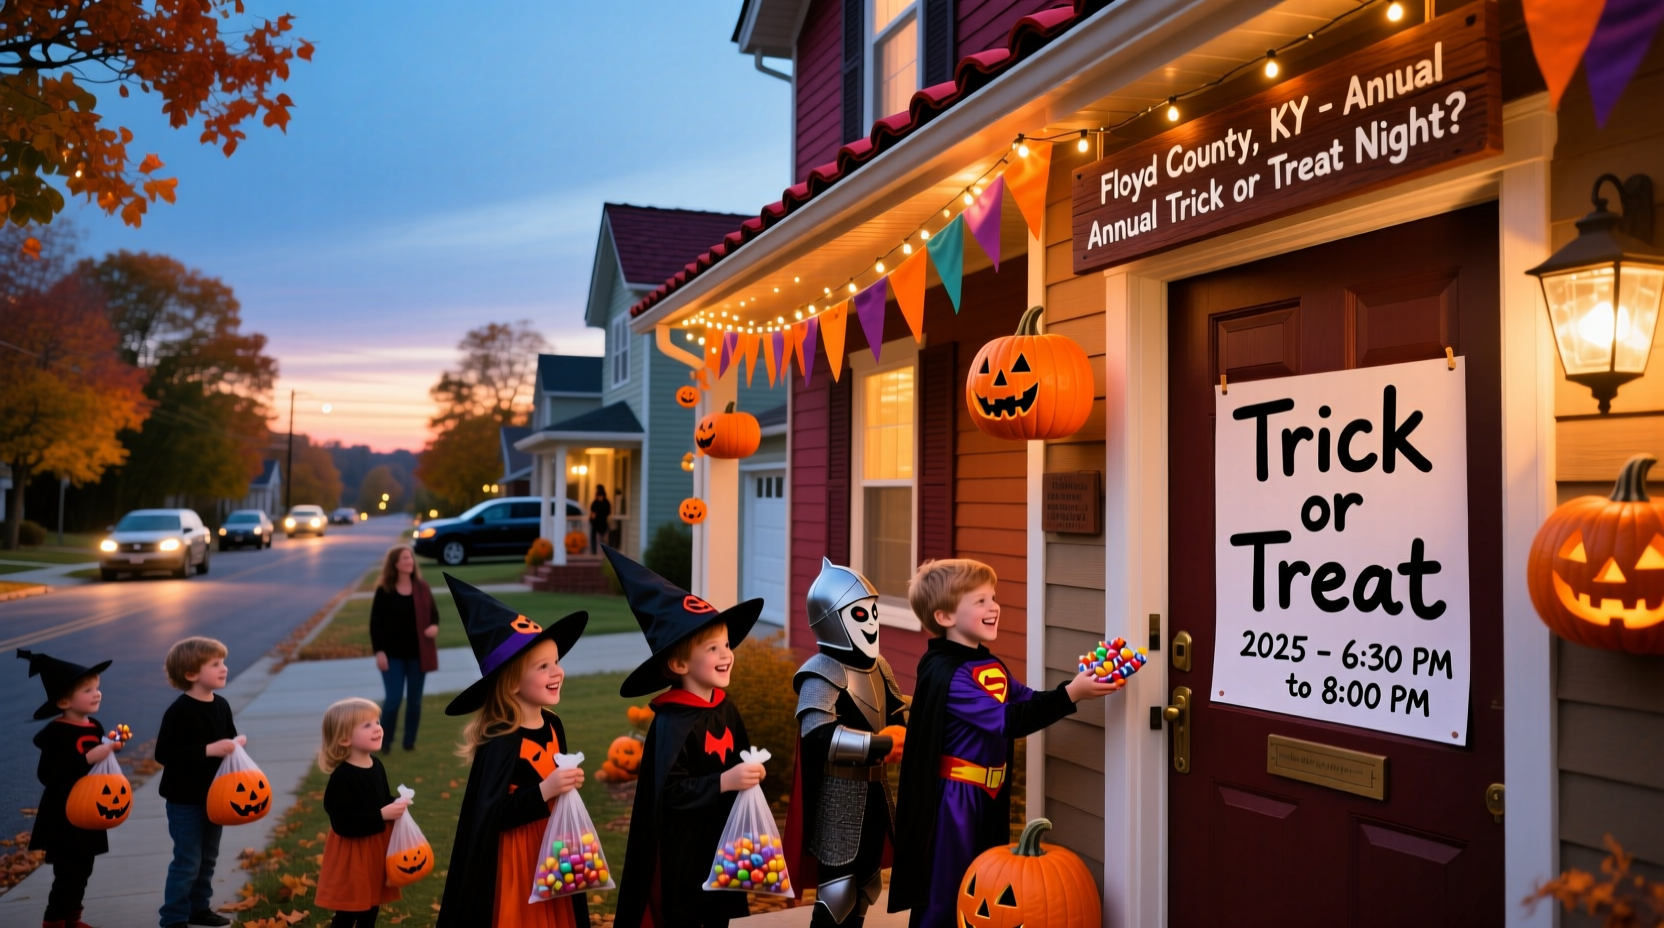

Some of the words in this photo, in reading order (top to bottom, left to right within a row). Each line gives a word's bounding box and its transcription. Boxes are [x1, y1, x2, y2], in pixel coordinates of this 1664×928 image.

[1087, 198, 1158, 250] Annual
[1166, 178, 1224, 224] Trick
[1233, 173, 1260, 203] or
[1268, 138, 1344, 190] Treat
[1356, 90, 1467, 164] Night?
[1101, 154, 1157, 204] Floyd
[1166, 128, 1259, 177] County,
[1271, 96, 1309, 142] KY
[1232, 384, 1433, 482] Trick
[1300, 492, 1364, 532] or
[1230, 530, 1447, 620] Treat
[1239, 630, 1308, 662] 2025
[1341, 639, 1402, 673] 6:30
[1412, 647, 1453, 680] PM
[1285, 672, 1312, 698] to
[1321, 676, 1381, 710] 8:00
[1390, 685, 1430, 717] PM
